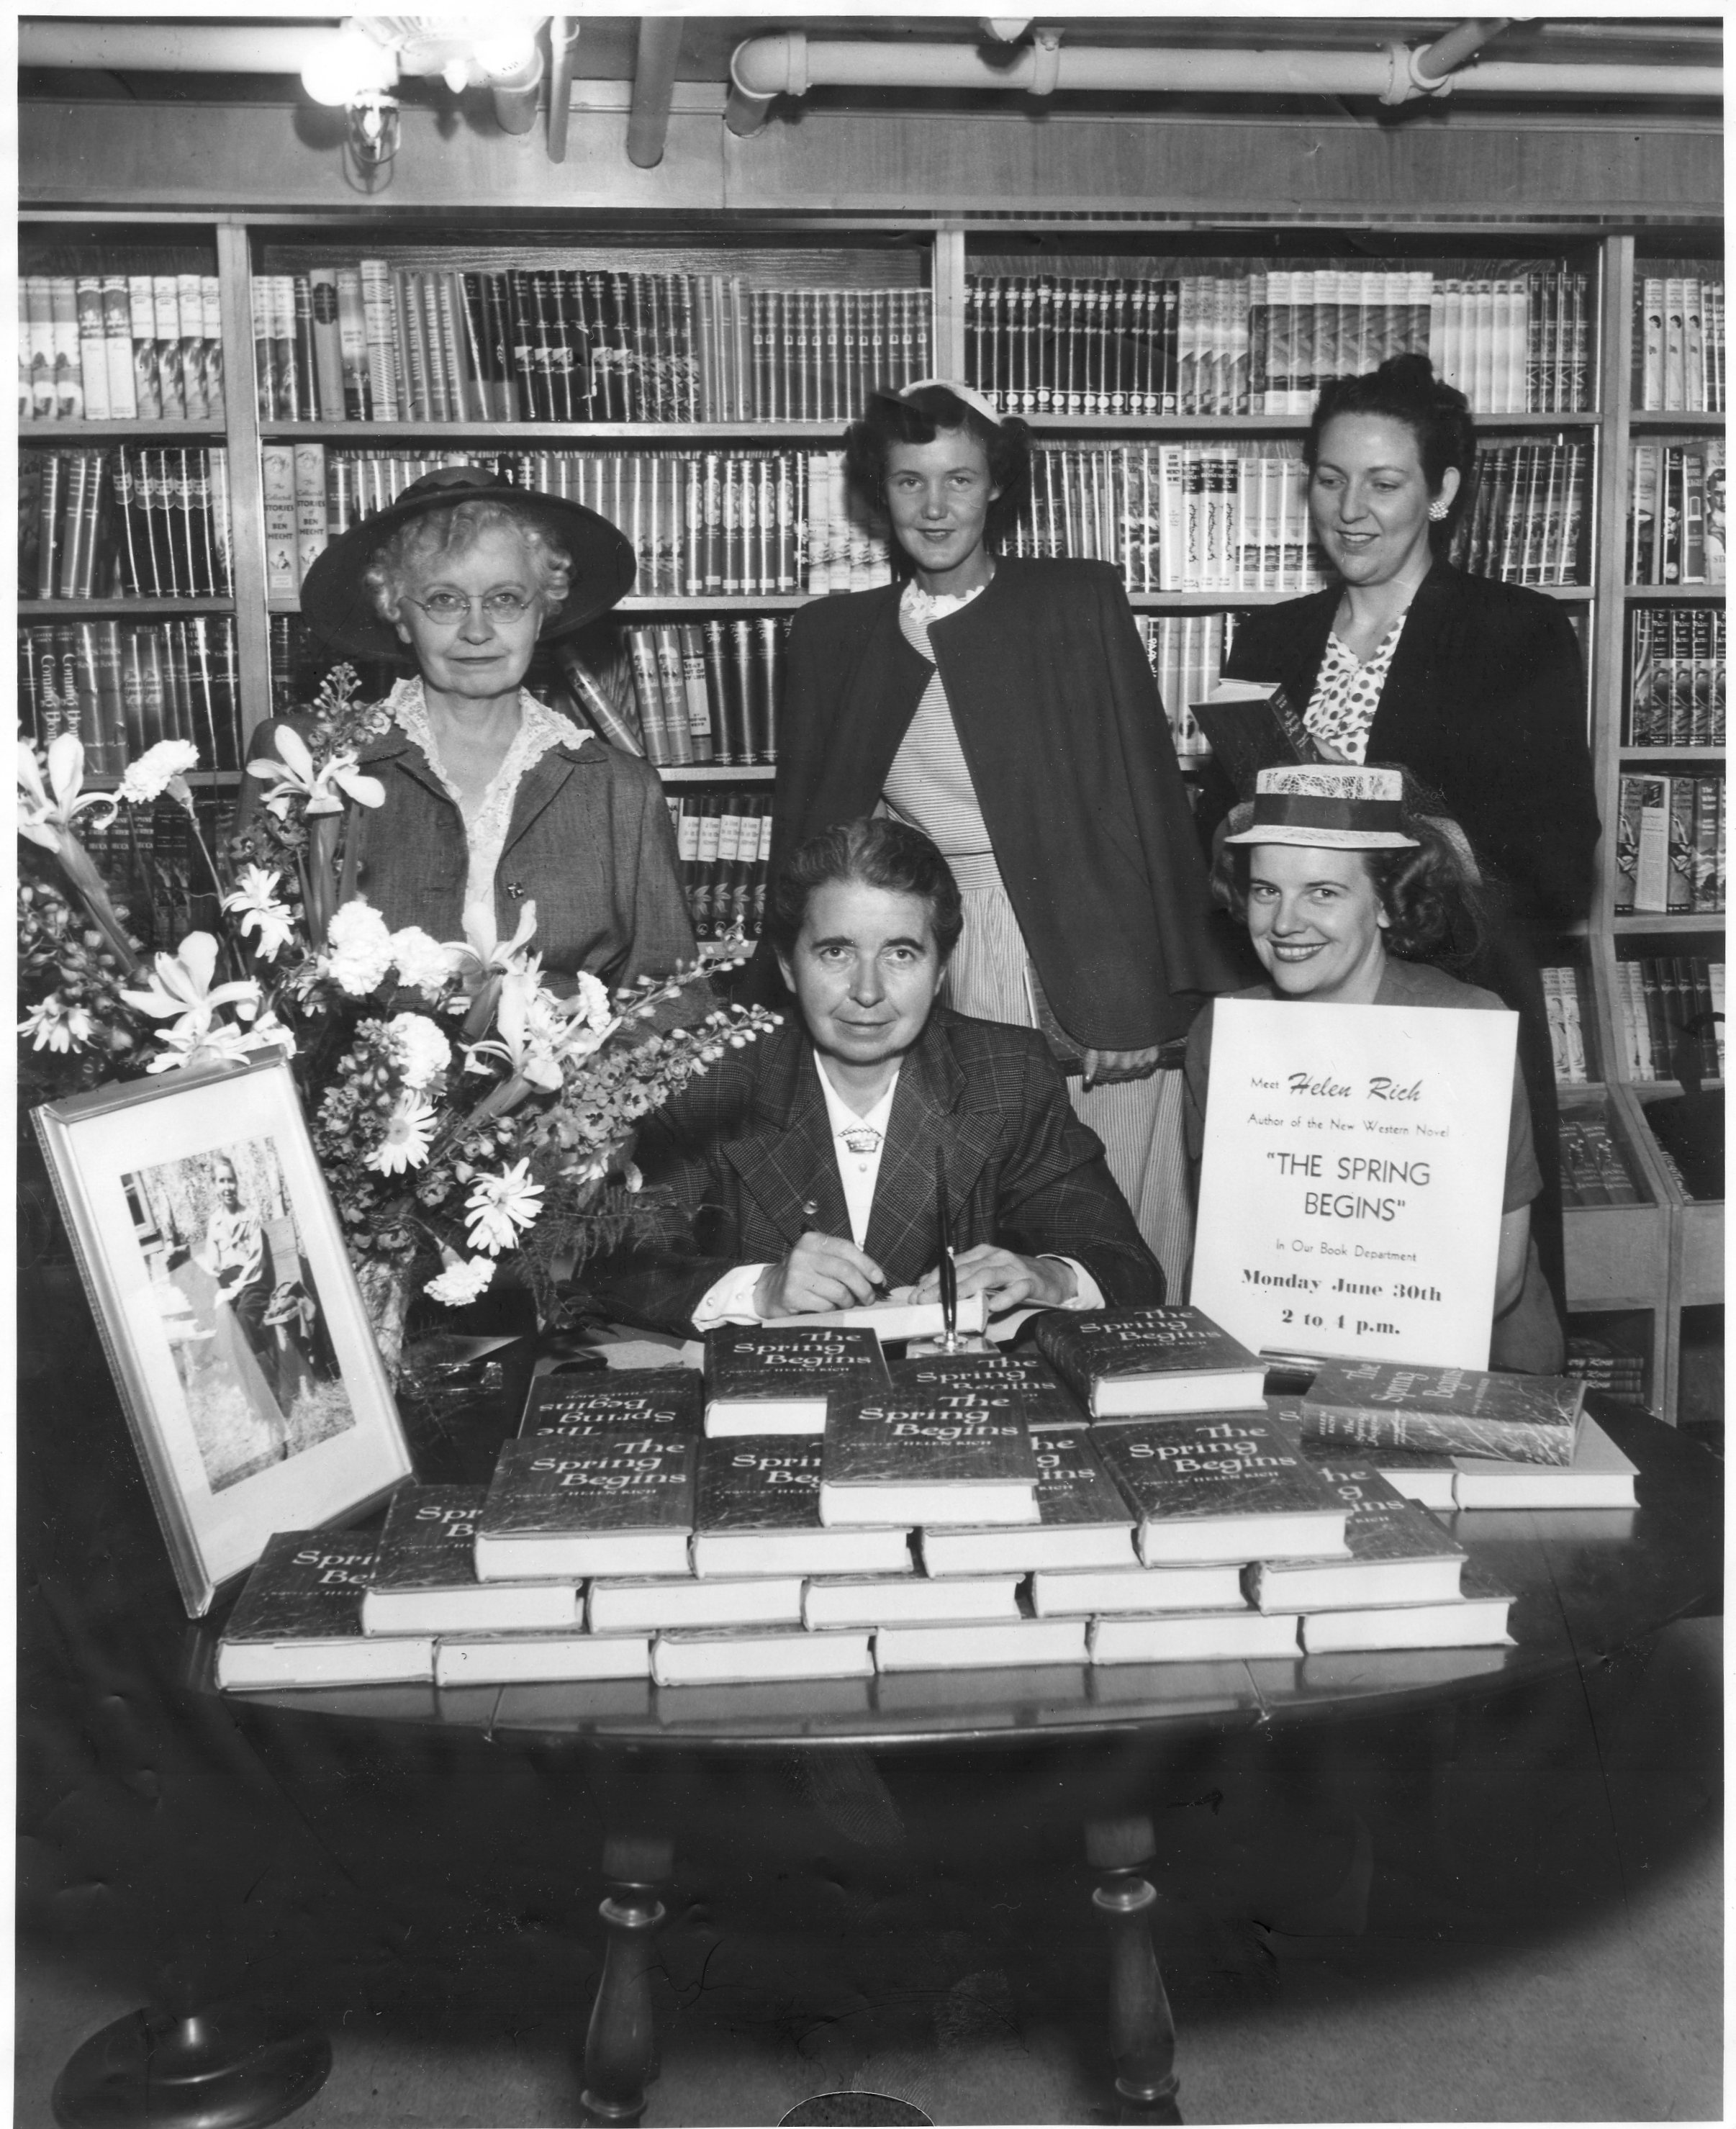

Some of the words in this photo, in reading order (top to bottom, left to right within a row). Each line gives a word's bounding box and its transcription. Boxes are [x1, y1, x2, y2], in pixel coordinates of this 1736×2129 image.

[40, 654, 56, 708] Coming
[1251, 1077, 1279, 1090] Meet
[1288, 1072, 1352, 1098] Helen
[1367, 1076, 1423, 1101] Rich
[1247, 1113, 1284, 1126] Author
[1290, 1116, 1302, 1128] of
[1307, 1117, 1324, 1130] the
[1330, 1118, 1355, 1131] New
[1362, 1119, 1410, 1136] Western
[1415, 1123, 1450, 1138] Novel
[1337, 1157, 1431, 1186] SPRING
[1276, 1239, 1285, 1250] In
[1291, 1239, 1314, 1253] Our
[1320, 1242, 1348, 1257] Book
[1354, 1244, 1417, 1262] Department
[1241, 1268, 1322, 1294] Monday
[1332, 1277, 1383, 1297] June
[1393, 1283, 1442, 1302] 30th
[1134, 1308, 1197, 1319] The
[1080, 1320, 1188, 1333] Spring
[1281, 1308, 1293, 1324] 2
[1303, 1313, 1323, 1327] to
[1356, 1320, 1401, 1336] p.m.
[800, 1331, 862, 1342] The
[1118, 1331, 1222, 1343] Begins
[733, 1342, 846, 1355] Spring
[764, 1354, 872, 1368] Begins
[977, 1357, 1039, 1368] The
[916, 1370, 1026, 1384] Spring
[1340, 1363, 1382, 1380] The
[1370, 1371, 1429, 1403] Spring
[1422, 1369, 1473, 1398] Begins
[538, 1397, 648, 1411] Begins
[938, 1393, 1011, 1406] The
[559, 1409, 677, 1424] Spring
[859, 1408, 990, 1424] Spring
[535, 1426, 603, 1437] The
[891, 1423, 1019, 1440] Begins
[1195, 1424, 1270, 1439] The
[613, 1438, 686, 1455] The
[1031, 1436, 1077, 1451] he
[1129, 1439, 1259, 1460] Spring
[530, 1457, 663, 1474] Spring
[731, 1454, 822, 1470] Spri
[1173, 1454, 1298, 1474] Begins
[559, 1472, 687, 1490] Begins
[1041, 1468, 1096, 1480] ins
[1317, 1467, 1372, 1483] he
[1351, 1499, 1405, 1512] ins
[415, 1506, 484, 1523] Spr
[291, 1550, 379, 1569] Spri
